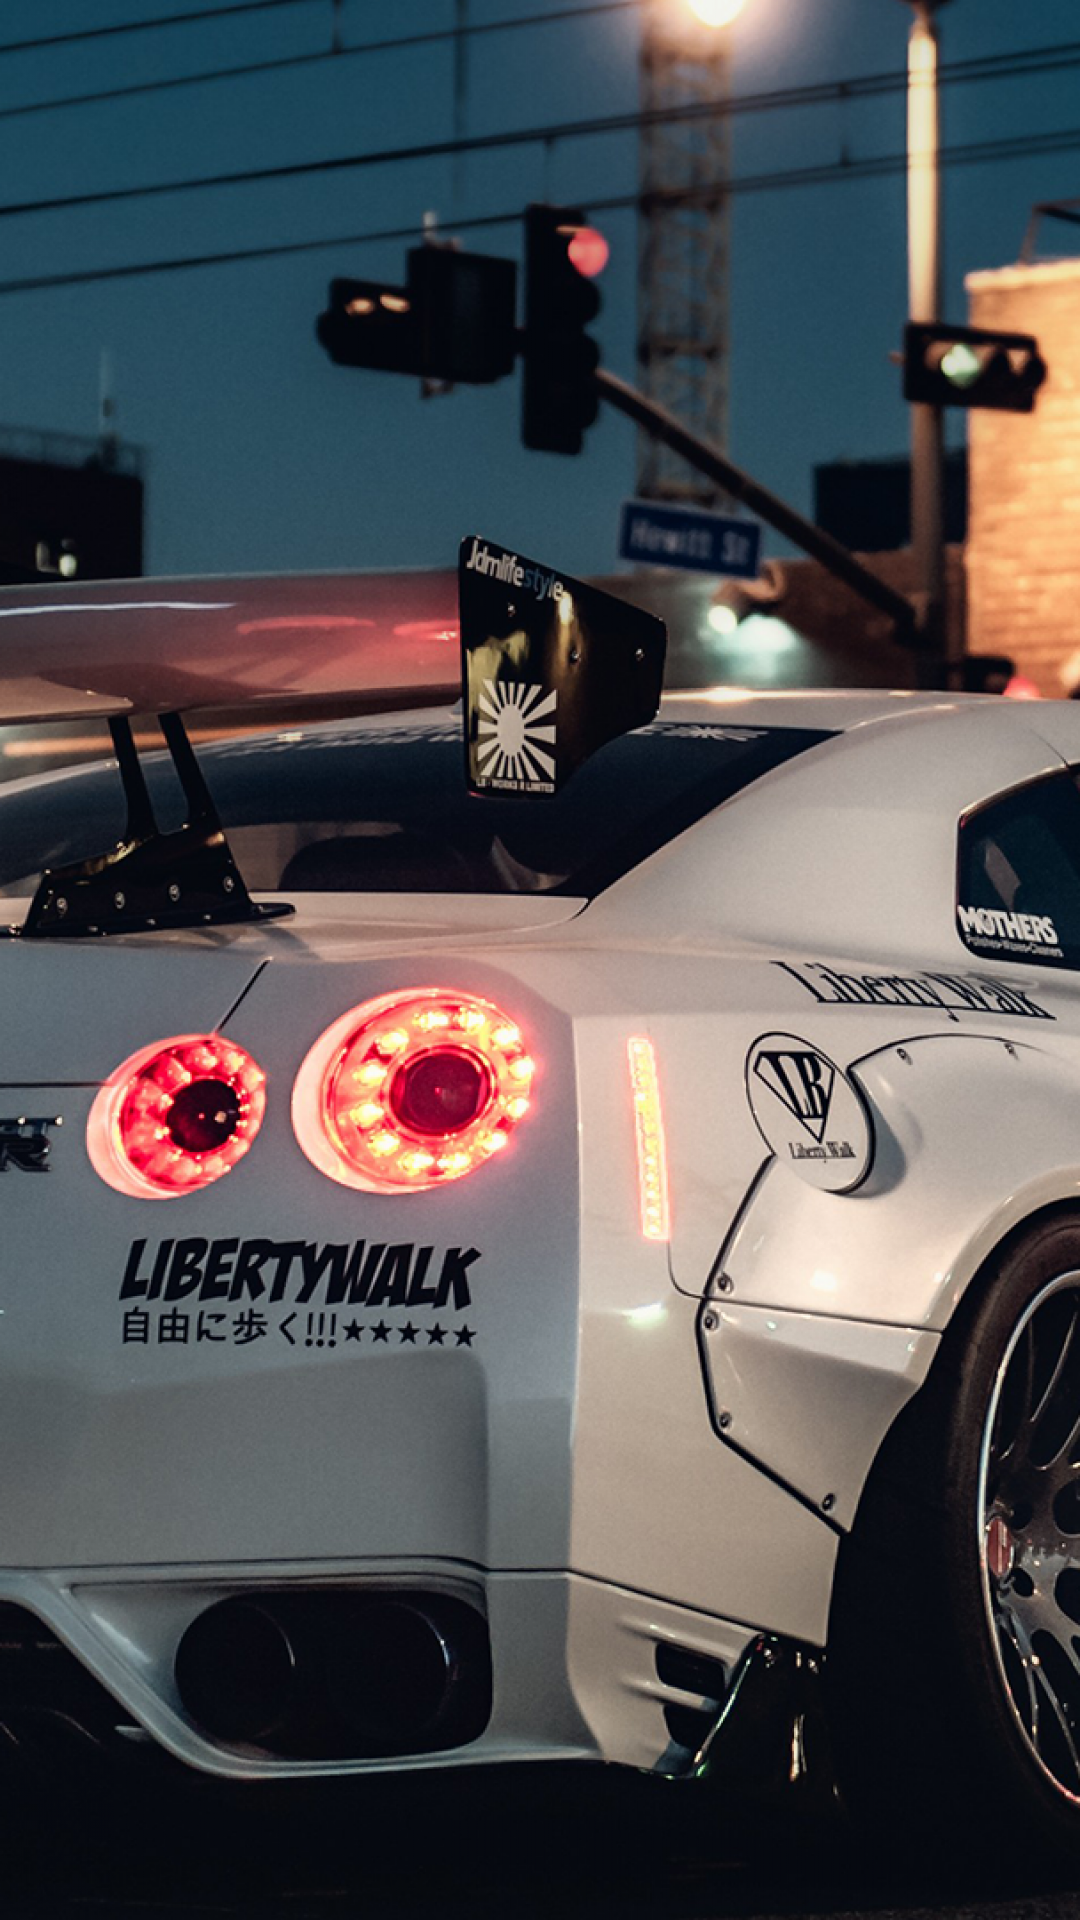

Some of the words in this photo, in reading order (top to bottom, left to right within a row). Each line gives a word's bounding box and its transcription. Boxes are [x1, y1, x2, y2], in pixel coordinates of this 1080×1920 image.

[721, 531, 750, 566] St
[957, 905, 1059, 944] MOTHERS
[769, 960, 958, 1022] Liberty
[918, 971, 1056, 1020] Walk
[119, 1237, 482, 1310] LIBERTYWALK
